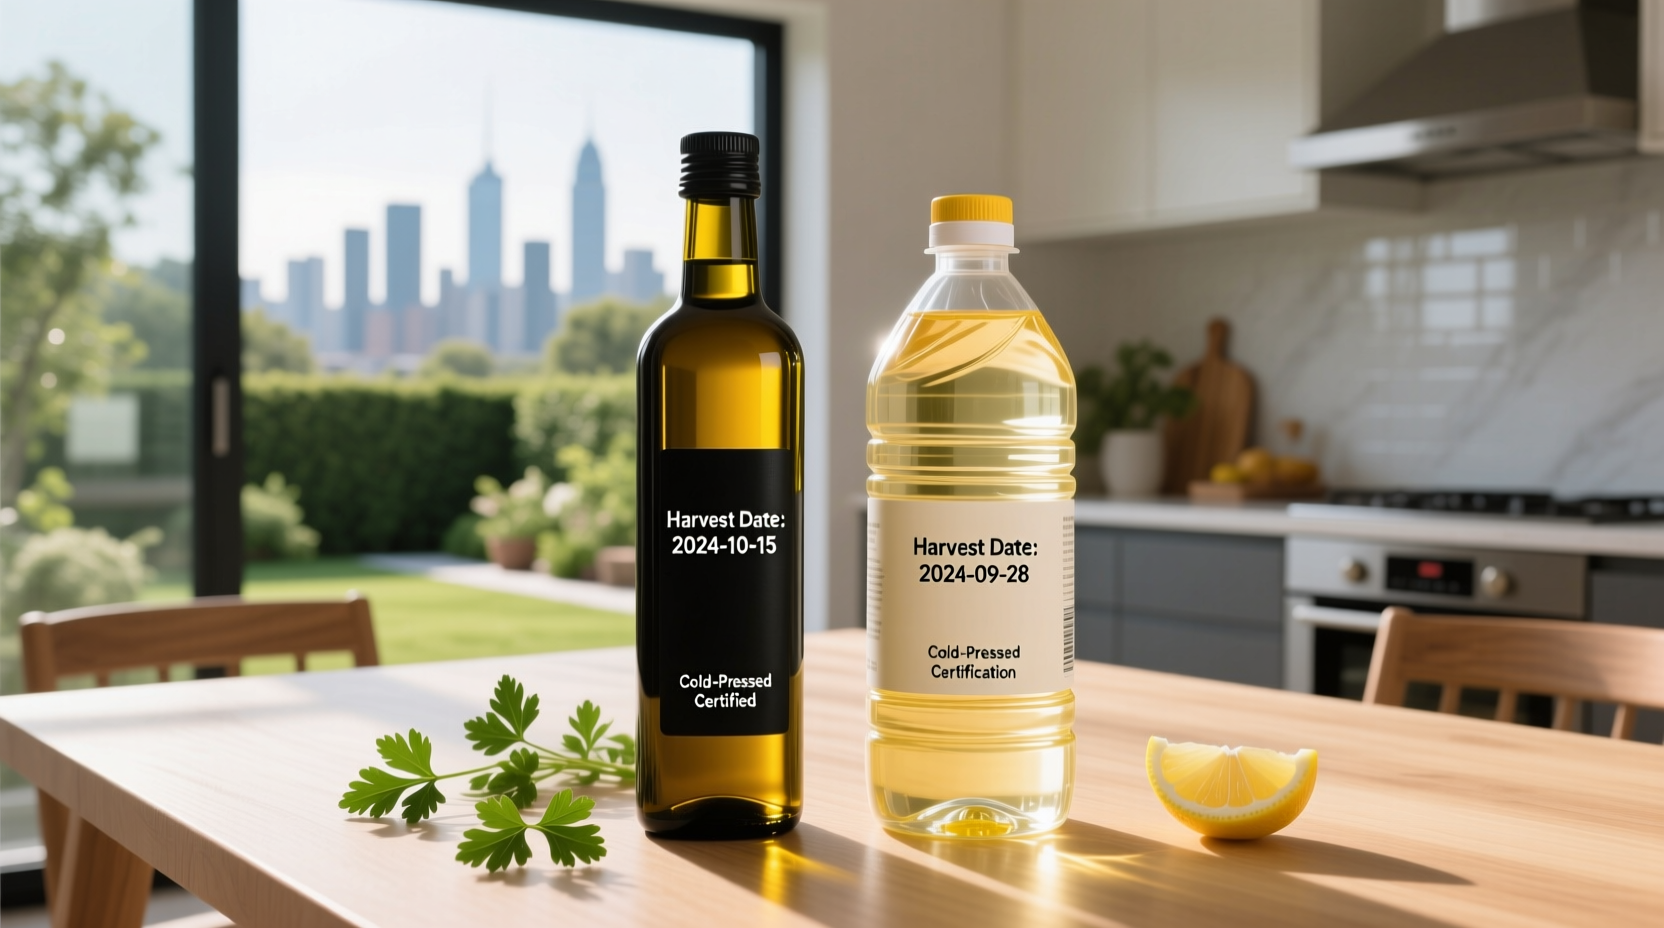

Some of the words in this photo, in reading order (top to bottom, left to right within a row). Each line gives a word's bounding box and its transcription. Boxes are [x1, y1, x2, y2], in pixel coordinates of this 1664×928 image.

[667, 510, 735, 528] Harvest
[739, 511, 785, 528] Date:
[672, 535, 777, 554] 2024-10-15
[913, 537, 985, 556] Harvest
[990, 538, 1038, 556] Date:
[919, 564, 1029, 583] 2024-09-28
[928, 645, 1020, 659] Cold-Pressed
[931, 665, 1016, 679] Certification
[679, 673, 772, 689] Cold-Pressed
[694, 692, 757, 708] Certified
